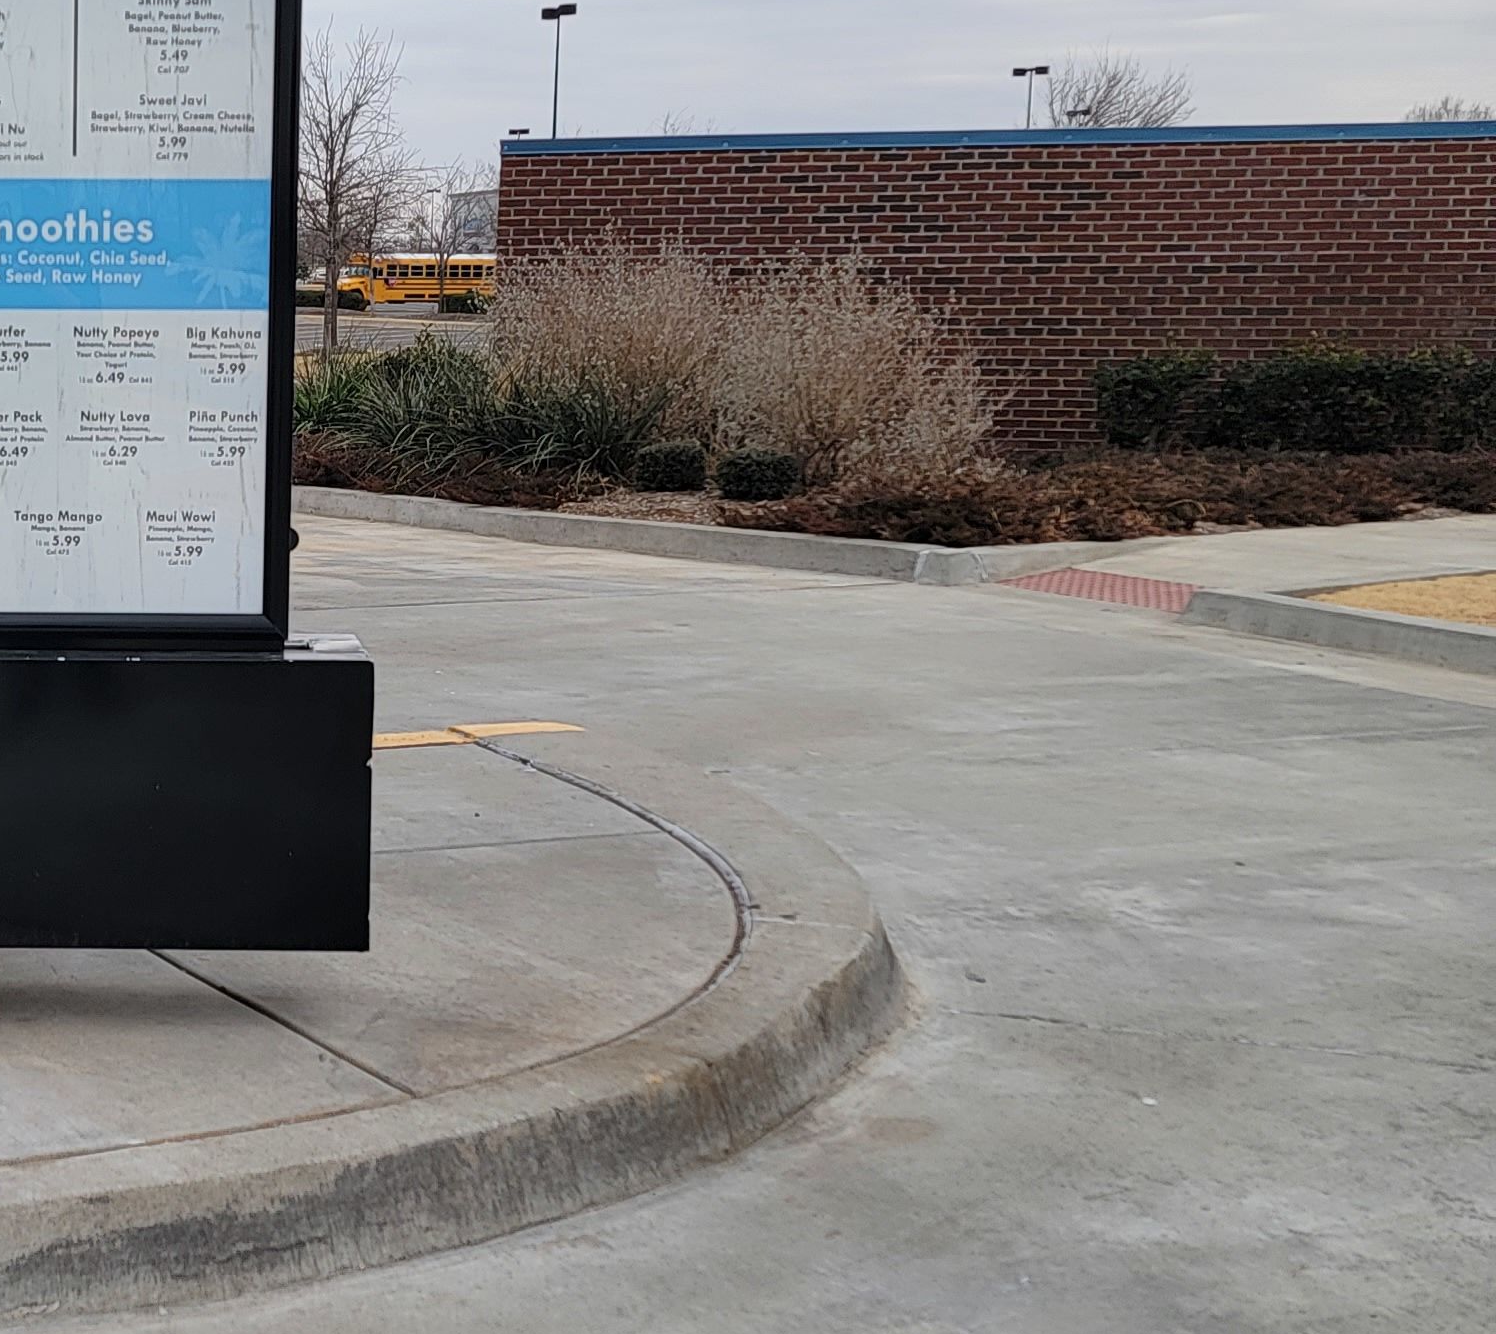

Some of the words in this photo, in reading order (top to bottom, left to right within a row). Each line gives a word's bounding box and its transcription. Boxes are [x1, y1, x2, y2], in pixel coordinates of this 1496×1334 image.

[160, 49, 188, 62] 5.49
[139, 94, 177, 105] Sweet
[8, 123, 25, 135] Nu
[158, 136, 186, 148] 5.99
[18, 250, 84, 267] Coconut,
[90, 250, 125, 265] Chia
[130, 250, 171, 267] Seed,
[6, 268, 46, 284] Seed,
[52, 269, 86, 283] Raw
[92, 269, 142, 287] Honey
[73, 326, 108, 341] Nutty
[113, 326, 159, 341] Popeye
[186, 327, 206, 342] Big
[211, 327, 262, 339] Kahuna
[0, 351, 29, 363] 5.99
[217, 362, 246, 375] 5.99
[96, 371, 125, 383] 6.49
[14, 411, 42, 422] Pack
[80, 410, 115, 425] Nutty
[120, 411, 150, 422] Lova
[189, 411, 216, 422] Piña
[221, 411, 258, 423] Punch
[0, 446, 28, 457] 6.49
[108, 445, 138, 457] 6.29
[217, 446, 246, 459] 5.99
[14, 510, 53, 524] Tango
[58, 510, 102, 524] Mango
[146, 511, 177, 522] Maui
[181, 511, 215, 522] Wowi
[52, 535, 80, 547] 5.99
[174, 545, 203, 557] 5.99
